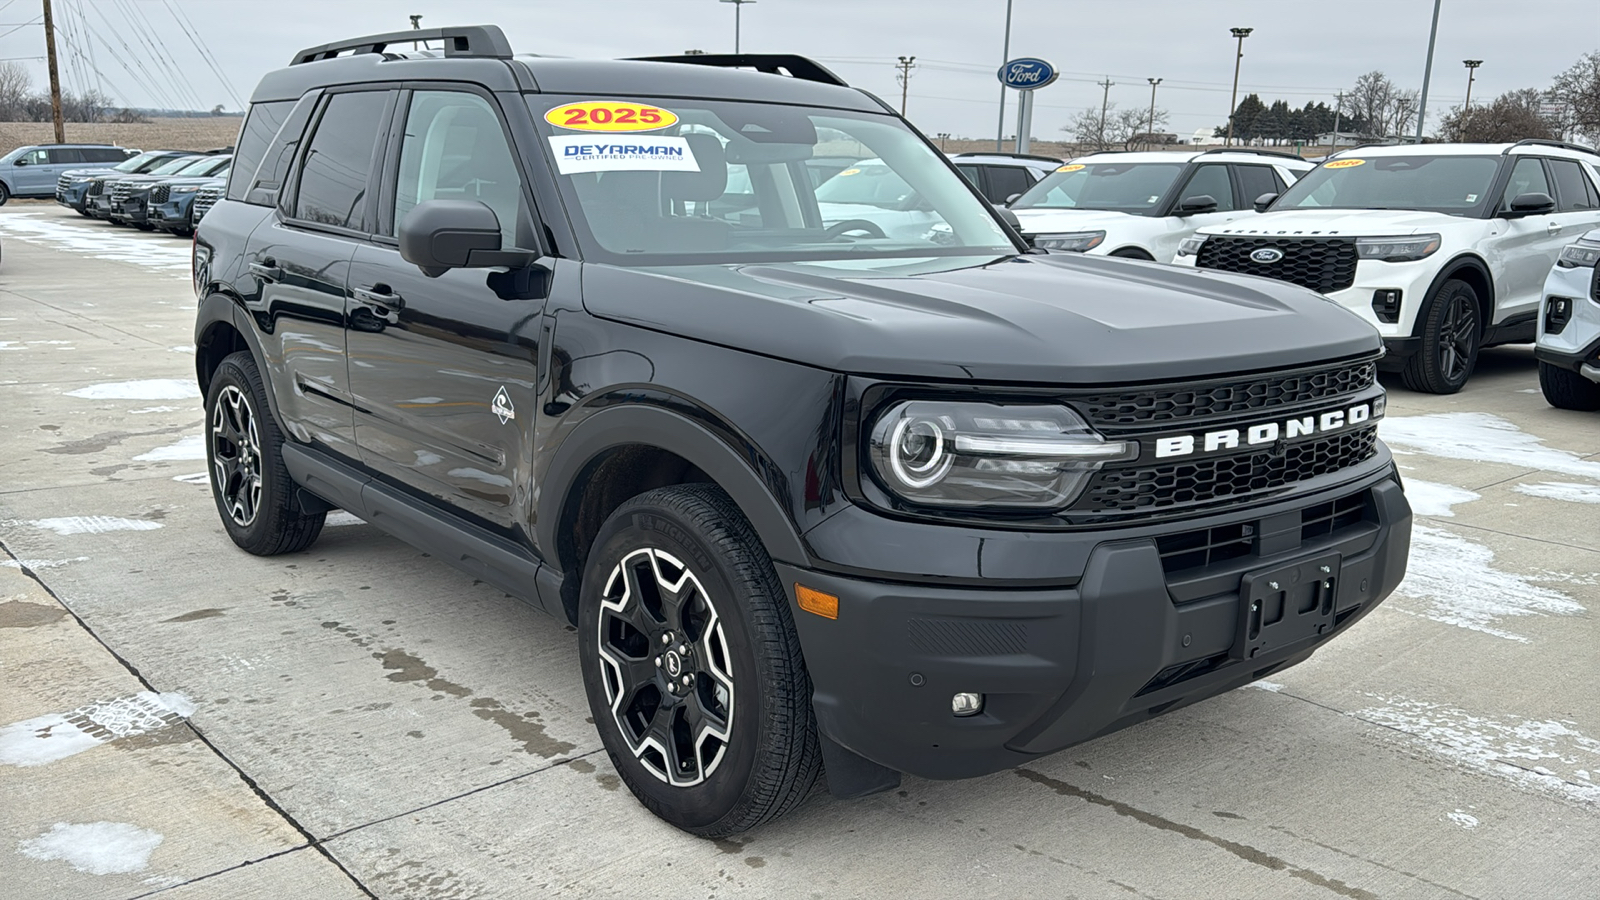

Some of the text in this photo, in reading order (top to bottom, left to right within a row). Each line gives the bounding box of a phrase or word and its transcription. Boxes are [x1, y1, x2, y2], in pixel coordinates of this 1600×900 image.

[1008, 63, 1043, 83] Ford
[564, 108, 661, 124] 2025
[564, 144, 682, 156] DEYARMAN
[1256, 251, 1275, 260] Ford
[1155, 404, 1370, 459] BRONCO
[655, 519, 710, 568] MICHELIN
